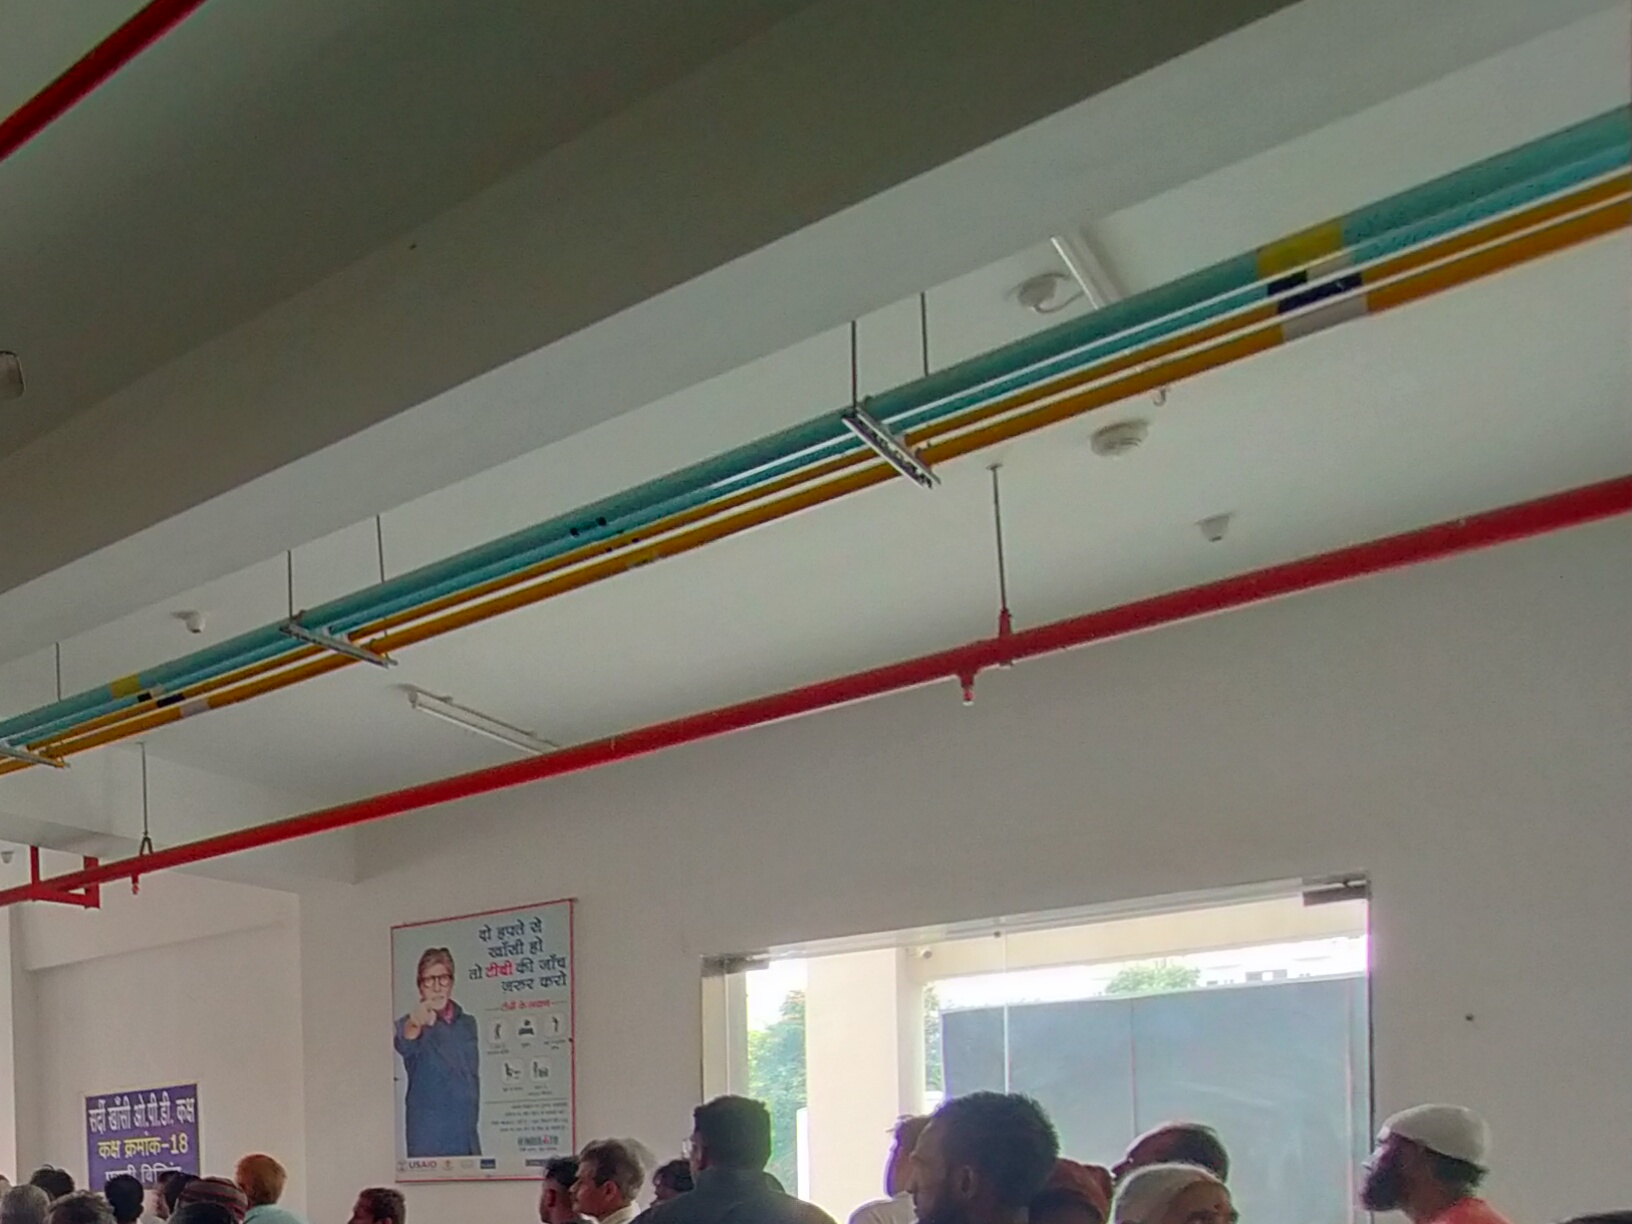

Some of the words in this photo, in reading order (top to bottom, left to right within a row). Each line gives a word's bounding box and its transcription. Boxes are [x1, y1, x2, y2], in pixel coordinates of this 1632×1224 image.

[478, 924, 492, 943] दो
[529, 916, 543, 934] से
[529, 936, 543, 955] हो
[469, 963, 483, 981] तो
[485, 960, 514, 978] टीबी
[516, 957, 534, 974] की
[540, 970, 567, 987] करो
[176, 1098, 195, 1123] कक्ष
[98, 1140, 121, 1159] कक्ष
